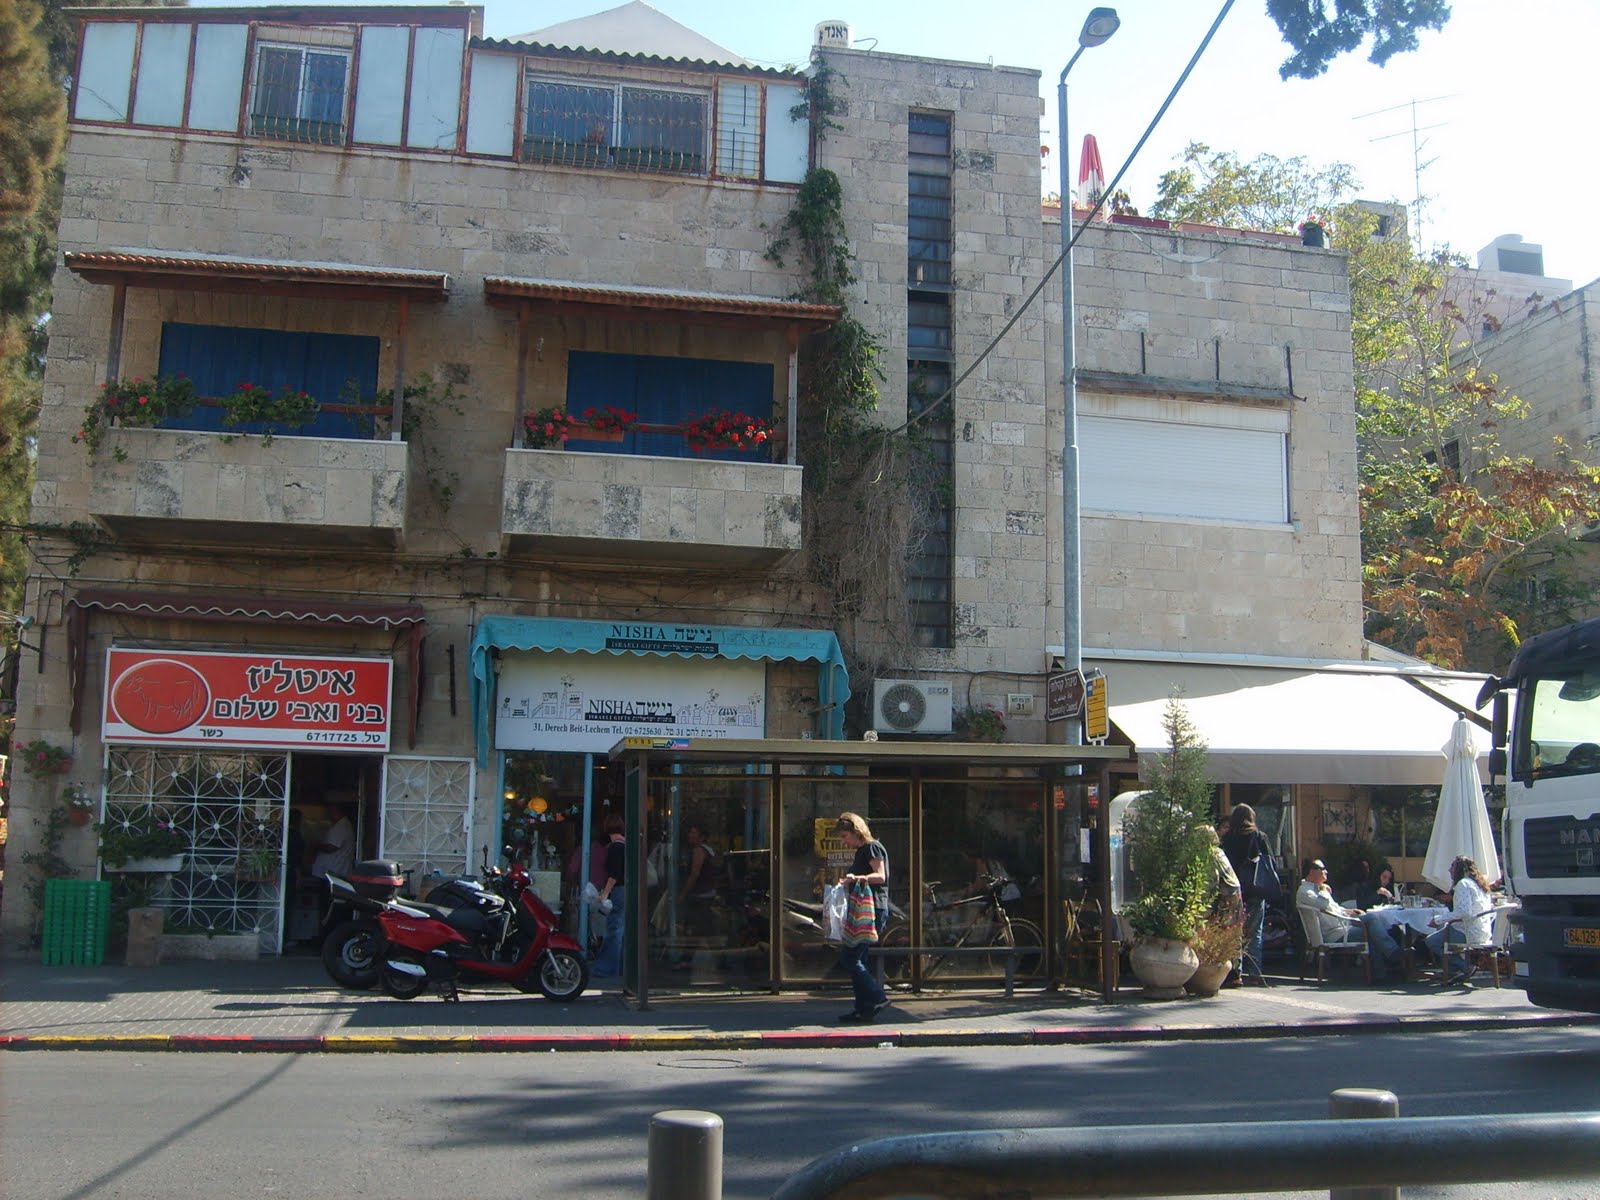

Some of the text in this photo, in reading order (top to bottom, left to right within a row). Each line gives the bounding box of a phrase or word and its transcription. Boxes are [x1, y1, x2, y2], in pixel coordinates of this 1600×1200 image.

[611, 624, 666, 639] NISHA
[675, 628, 711, 641] נישה
[611, 641, 639, 649] ISRAELI
[247, 660, 355, 695] איטליז
[213, 695, 385, 723] בני ואבי שלום
[589, 699, 634, 715] NISHA
[636, 701, 672, 716] נישה
[200, 727, 224, 738] כשר
[545, 723, 567, 732] Derech
[569, 724, 610, 734] Beit-Lechem
[612, 725, 623, 734] Tel.
[676, 728, 683, 736] 31
[701, 729, 712, 737] בית
[715, 729, 726, 738] דרך
[306, 731, 381, 743] טל. 6717725
